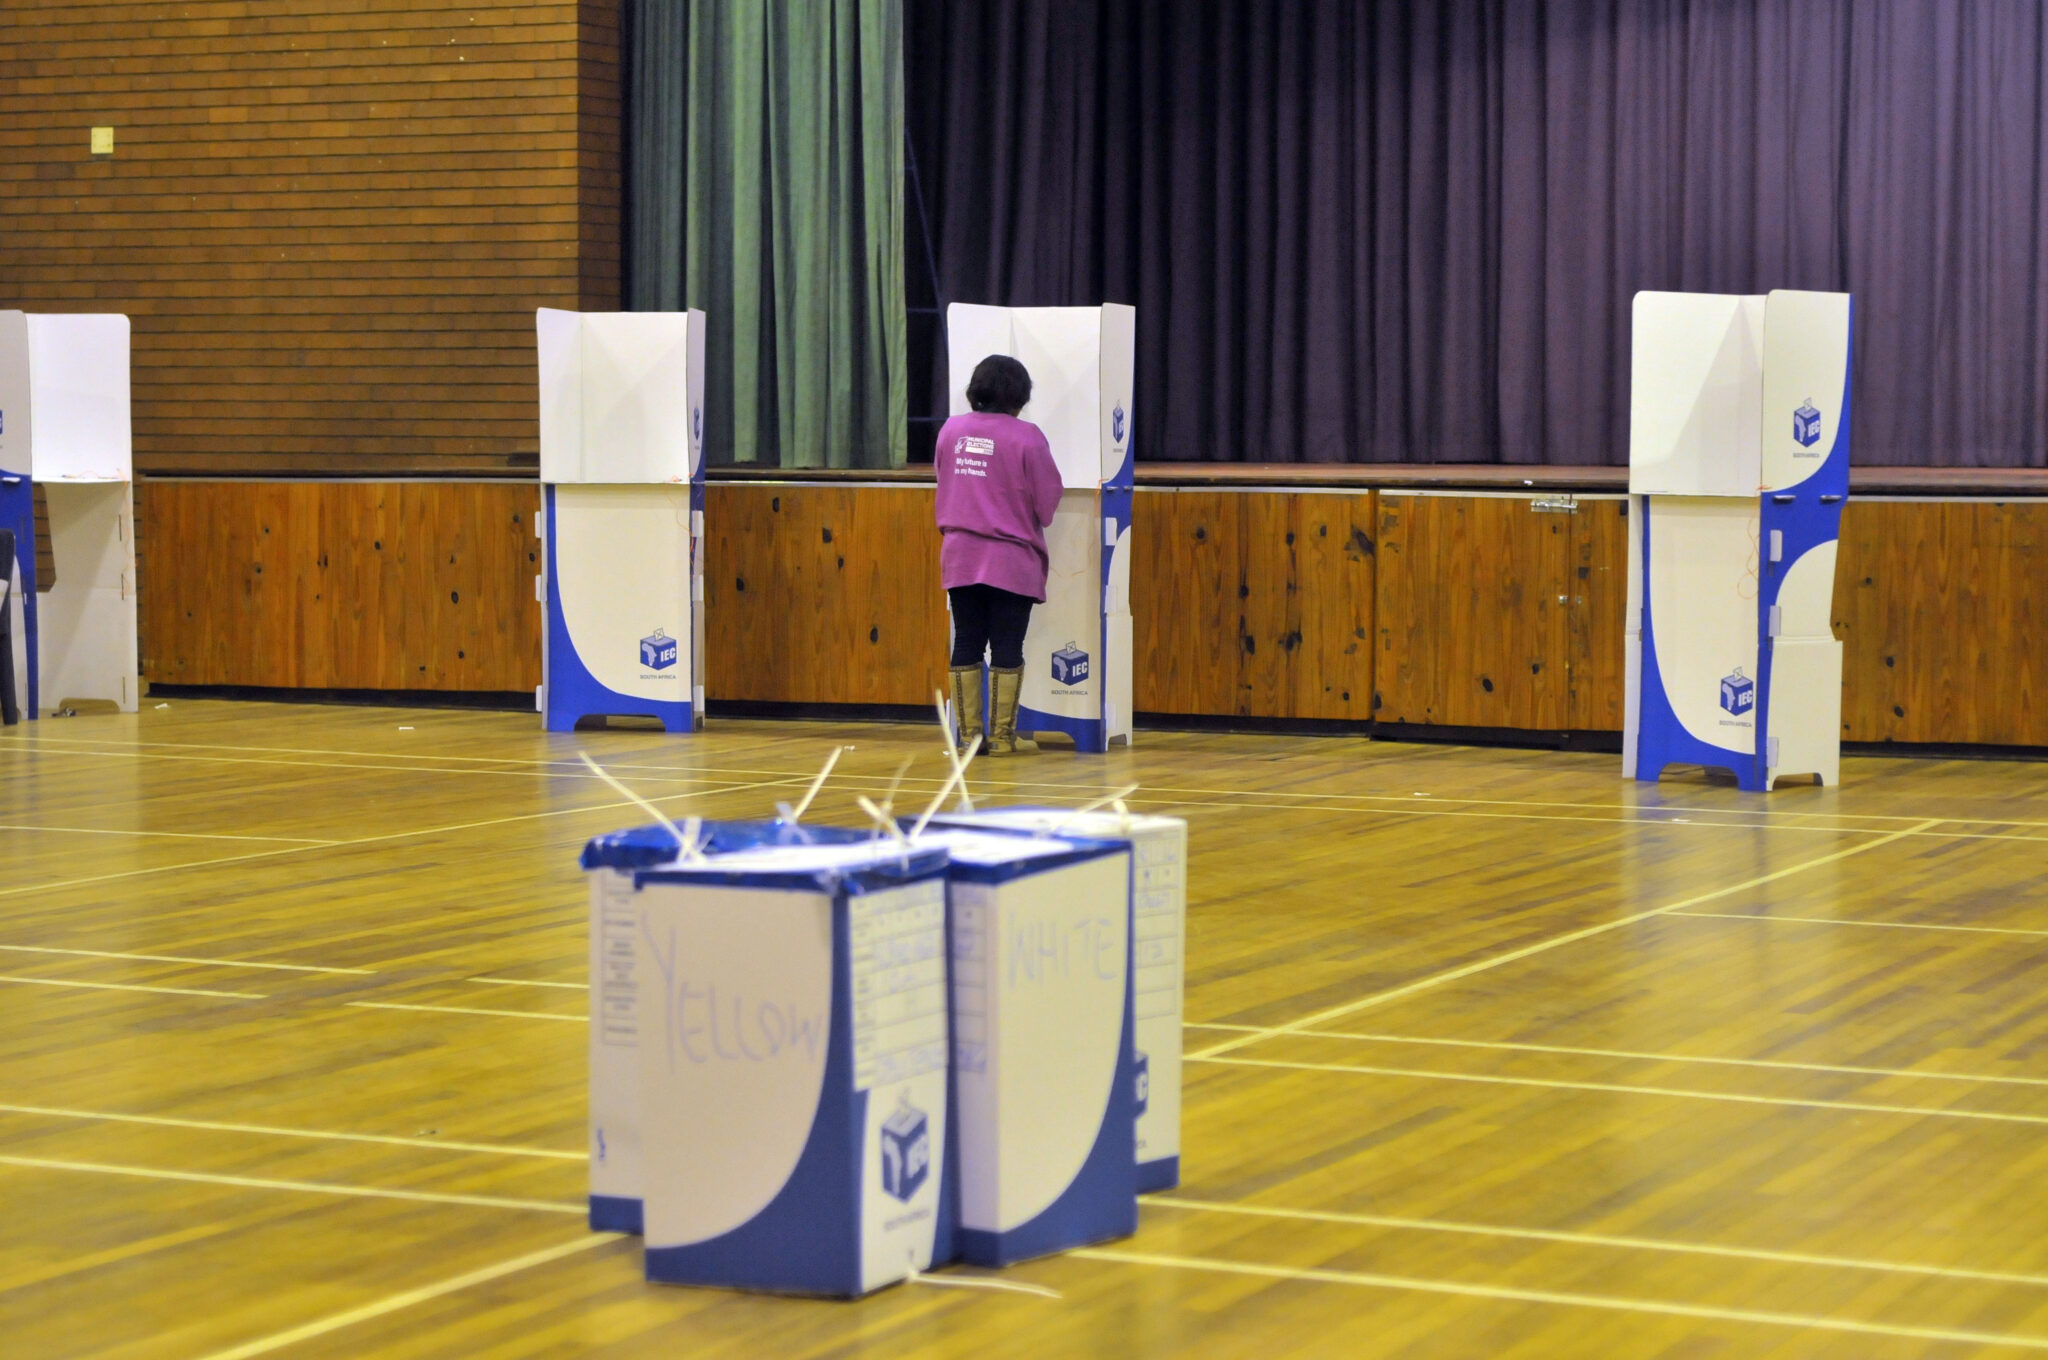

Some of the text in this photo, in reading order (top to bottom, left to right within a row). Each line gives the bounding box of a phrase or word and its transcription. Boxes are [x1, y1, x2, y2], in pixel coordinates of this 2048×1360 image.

[964, 458, 982, 467] future
[660, 647, 676, 662] IEC
[1072, 661, 1088, 677] IEC
[1738, 690, 1753, 707] IEC
[1007, 911, 1119, 990] WHITE
[640, 912, 823, 1076] YELLOW
